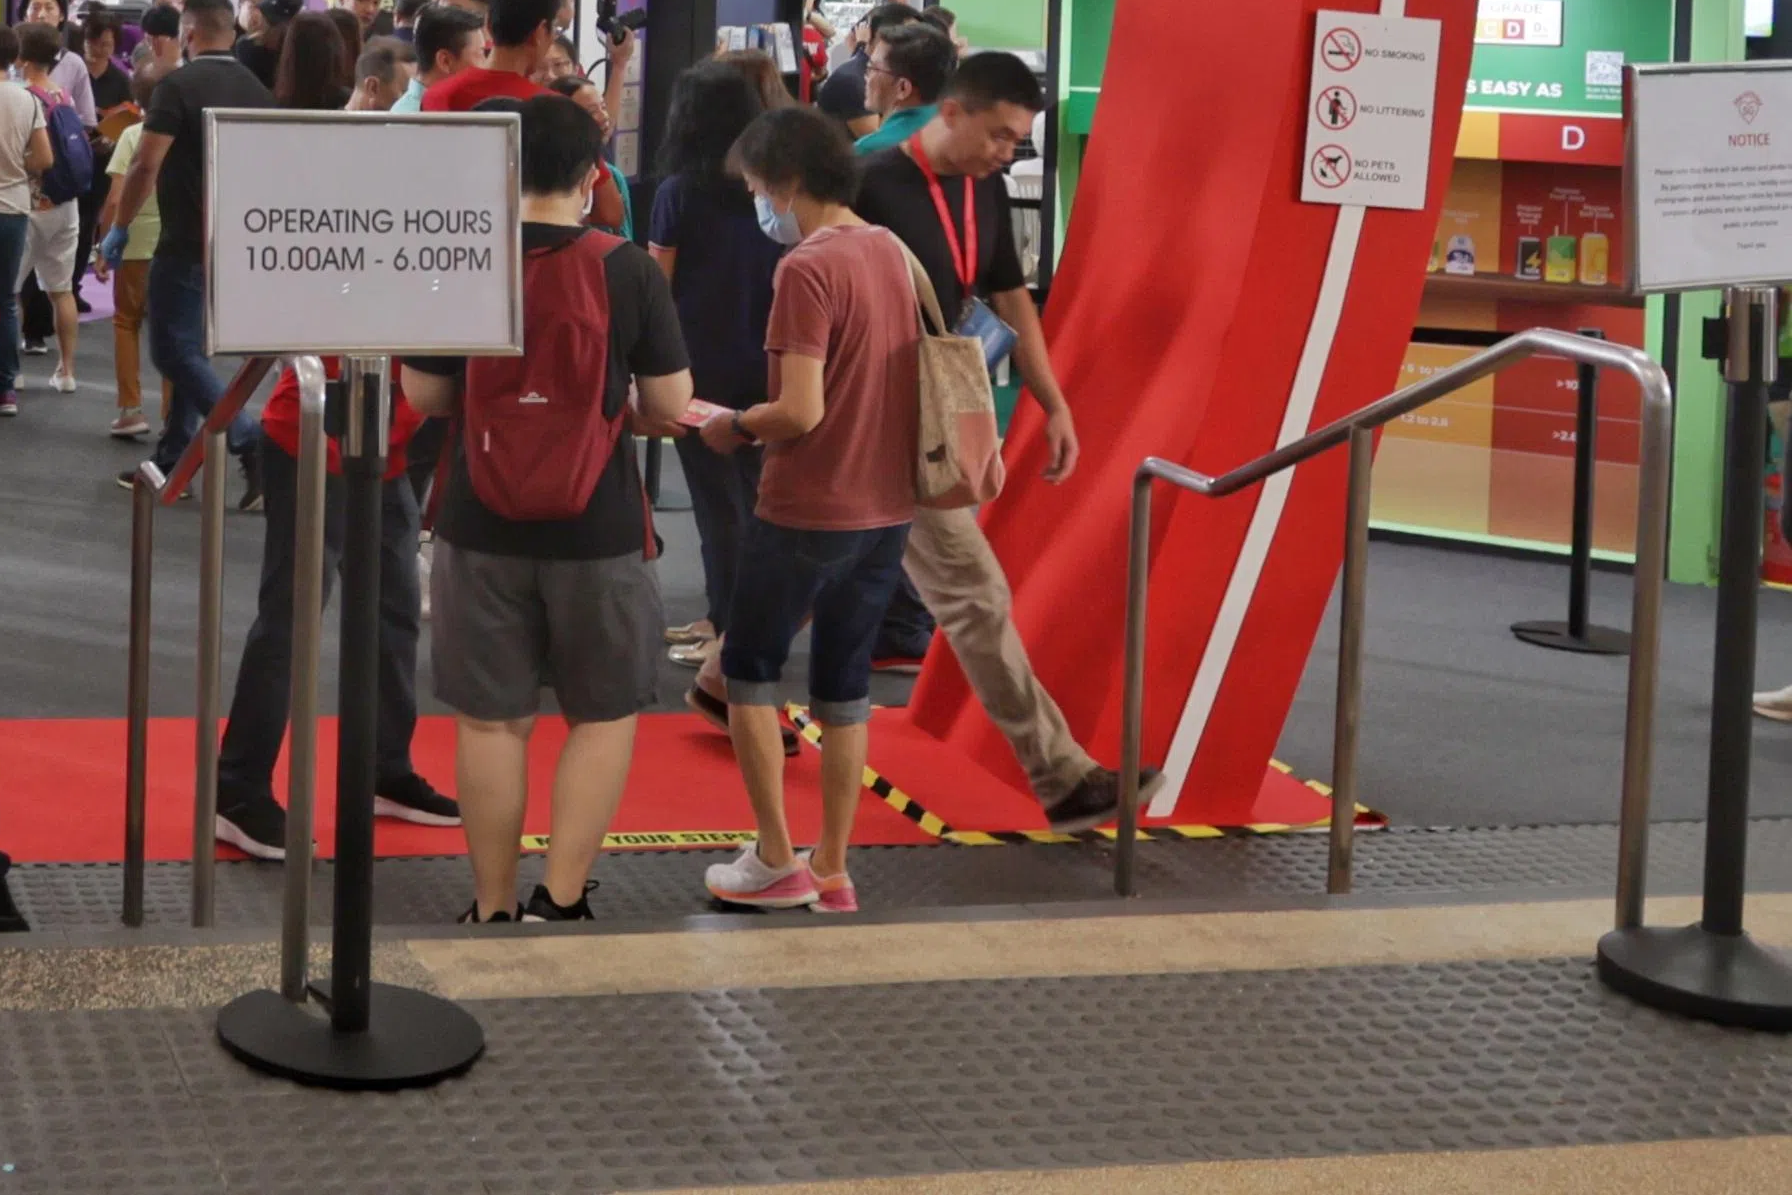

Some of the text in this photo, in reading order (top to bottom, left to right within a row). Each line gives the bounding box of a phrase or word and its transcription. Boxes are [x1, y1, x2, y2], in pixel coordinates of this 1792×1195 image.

[1364, 49, 1426, 62] NO SMOKING
[1481, 80, 1532, 96] EASY
[1535, 82, 1562, 98] AS
[1359, 105, 1426, 118] NO LITTERING
[1562, 125, 1585, 150] D
[1728, 133, 1771, 147] NOTICE
[1354, 160, 1396, 170] NO PETS
[1353, 172, 1401, 184] ALLOWED
[244, 208, 492, 234] OPERATING HOURS
[246, 246, 365, 271] 10.00AM
[393, 246, 492, 272] 6.00PM
[609, 832, 756, 846] YOUR STEPS
